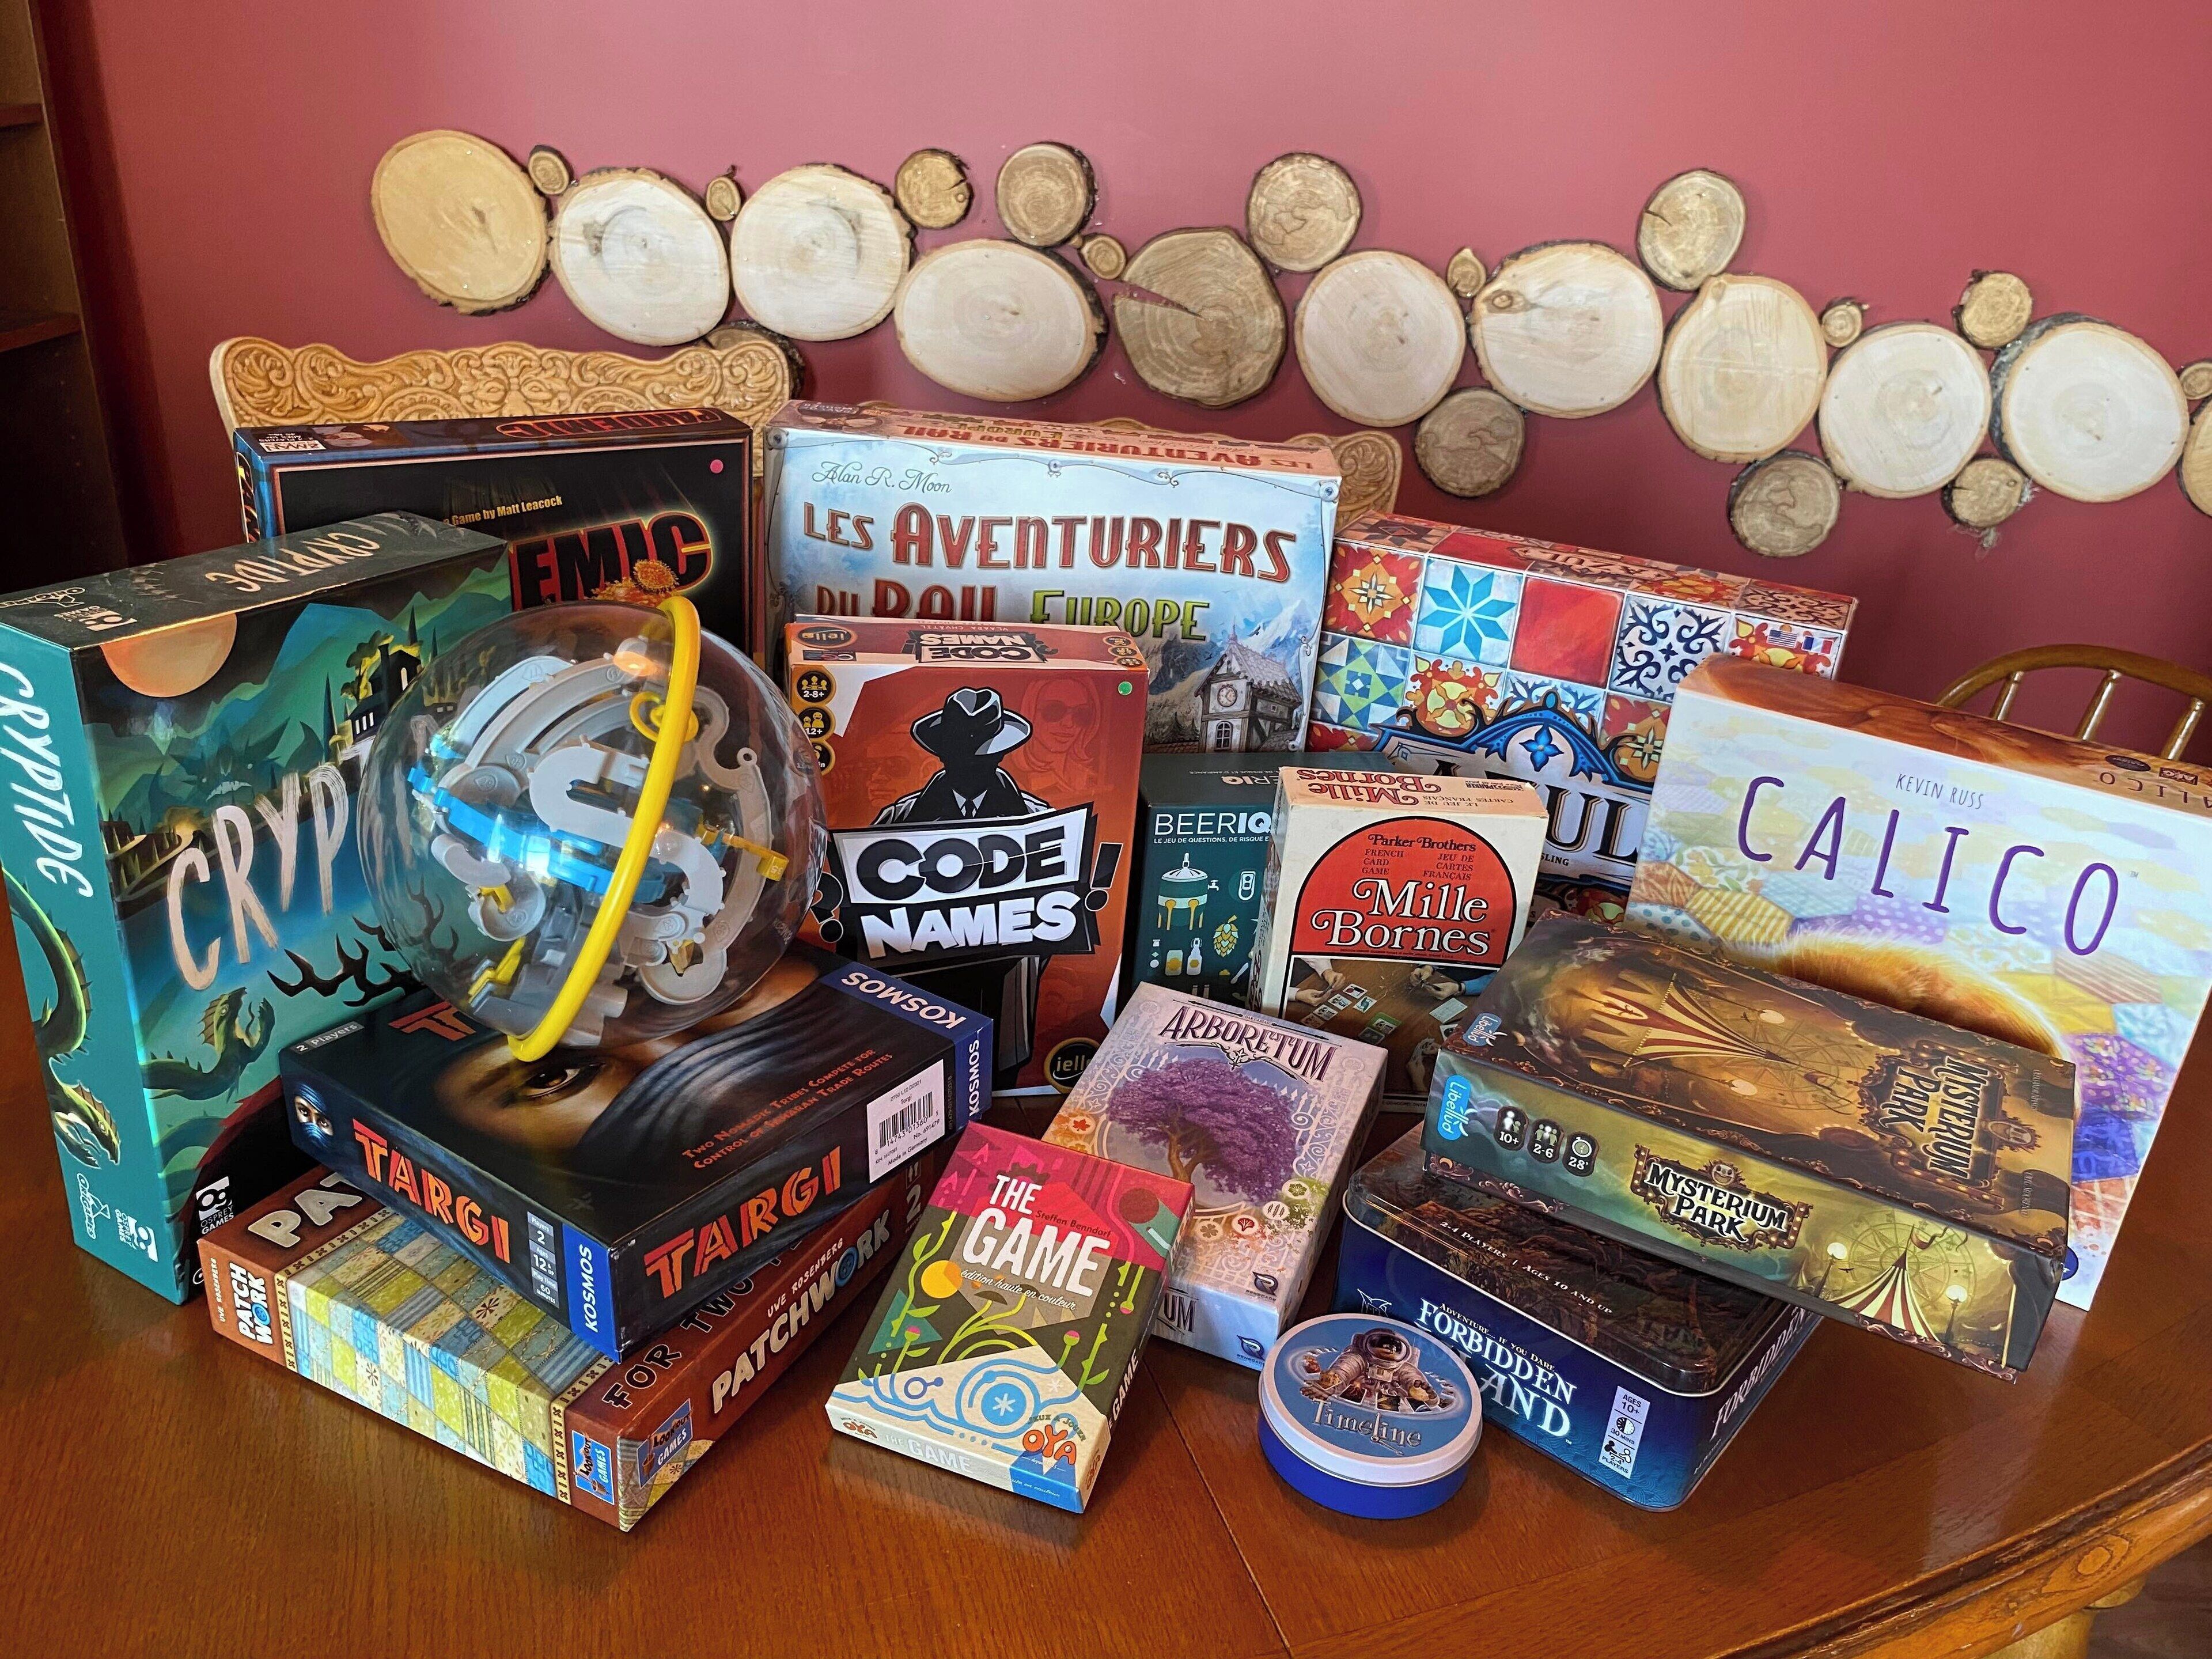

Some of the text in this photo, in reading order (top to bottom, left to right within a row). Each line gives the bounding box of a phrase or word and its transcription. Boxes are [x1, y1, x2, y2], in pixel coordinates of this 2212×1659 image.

[496, 408, 722, 438] PANDEMIC
[1014, 435, 1263, 467] AVENTURIERS
[812, 461, 952, 493] Alan R. Moon
[452, 495, 563, 526] Game by Matt Leacock
[803, 501, 1297, 584] LES AVENTURIERS
[205, 532, 381, 594] CRYPTIDE
[510, 511, 713, 612] EMIC
[815, 583, 859, 618] DU
[1029, 588, 1210, 641] EUROPE
[919, 634, 1027, 646] NAMES
[929, 646, 1031, 660] CODE
[803, 690, 825, 698] 2-8+
[0, 663, 94, 899] CRYPTIDE
[1297, 769, 1442, 794] Bornes
[1308, 782, 1419, 806] Mille
[1896, 772, 1986, 811] KEVIN RUSS
[2099, 771, 2212, 809] ALICO
[1154, 812, 1272, 836] BEERIQ
[1363, 857, 1389, 866] CARD
[1365, 849, 1404, 858] FRENCH
[1368, 834, 1476, 852] Parker Brothers
[1437, 853, 1474, 862] JEU DE
[1540, 851, 1570, 866] SLING
[856, 826, 1067, 902] CODE
[1361, 866, 1390, 876] GAME
[1422, 870, 1472, 881] FRANÇAIS
[1436, 862, 1474, 872] CARTES
[1737, 775, 2121, 957] CALICO
[1350, 877, 1490, 923] Mille
[861, 890, 1081, 960] NAMES
[1310, 908, 1492, 957] Bornes
[840, 971, 967, 1029] KOSMOS
[295, 1022, 358, 1053] 2 Players
[1157, 1005, 1338, 1082] ARBORETUM
[968, 1039, 980, 1117] KOSMOS
[681, 1141, 715, 1159] TWO
[770, 1087, 810, 1110] TRIBES
[808, 1061, 857, 1088] COMPETE
[855, 1048, 877, 1063] FOR
[693, 1137, 749, 1170] CONTROL
[749, 1126, 764, 1139] OF
[816, 1075, 854, 1097] TRADE
[851, 1053, 894, 1078] ROUTES
[900, 1094, 912, 1105] Targi
[1441, 1081, 1468, 1138] Libellud
[1878, 1066, 1941, 1134] PARK
[1920, 1055, 1990, 1180] MYSTERIUM
[923, 1119, 940, 1134] 691479
[1499, 1131, 1520, 1145] 10+
[888, 1137, 928, 1165] Made Germany
[1532, 1142, 1555, 1159] 2-6
[351, 1117, 513, 1265] TARGI
[906, 1184, 922, 1224] 2
[989, 1173, 1043, 1215] THE
[1644, 1163, 1787, 1232] MYSTERIUM
[200, 1205, 234, 1228] OSPREY
[201, 1212, 235, 1235] GAMES
[643, 1145, 841, 1300] TARGI
[1035, 1210, 1112, 1238] Steffen Benndorf
[1670, 1193, 1749, 1243] PARK
[537, 1230, 546, 1245] 2
[962, 1207, 1111, 1297] GAME
[533, 1253, 547, 1273] 12
[767, 1292, 787, 1319] UWE
[791, 1237, 844, 1295] ROSENBERG
[1440, 1221, 1613, 1315] 2-4 PLAYERS AGES 10 AND UP
[229, 1261, 257, 1340] PATCH
[540, 1284, 551, 1296] 60
[579, 1244, 599, 1333] KOSMOS
[960, 1269, 1078, 1311] édition haute en couleur
[247, 1272, 274, 1345] WORK
[713, 1209, 891, 1415] PATCHWORK
[1414, 1298, 1578, 1405] FORBIDDEN
[1498, 1336, 1508, 1346] IF
[1510, 1343, 1528, 1357] YOU
[601, 1343, 682, 1411] FOR
[1112, 1353, 1139, 1422] GAME
[1622, 1394, 1642, 1408] AGES
[1622, 1402, 1640, 1414] 10+
[843, 1421, 878, 1439] OYA
[1028, 1414, 1087, 1442] JEUX JOUER
[1311, 1397, 1422, 1449] Timeline
[1610, 1428, 1635, 1445] 30 MINS
[657, 1427, 688, 1467] GAMES
[907, 1438, 974, 1474] GAME
[1022, 1424, 1077, 1465] OYA
[1610, 1455, 1623, 1465] 2-4
[594, 1447, 609, 1484] GAMES
[1602, 1455, 1629, 1475] PLAYERS
